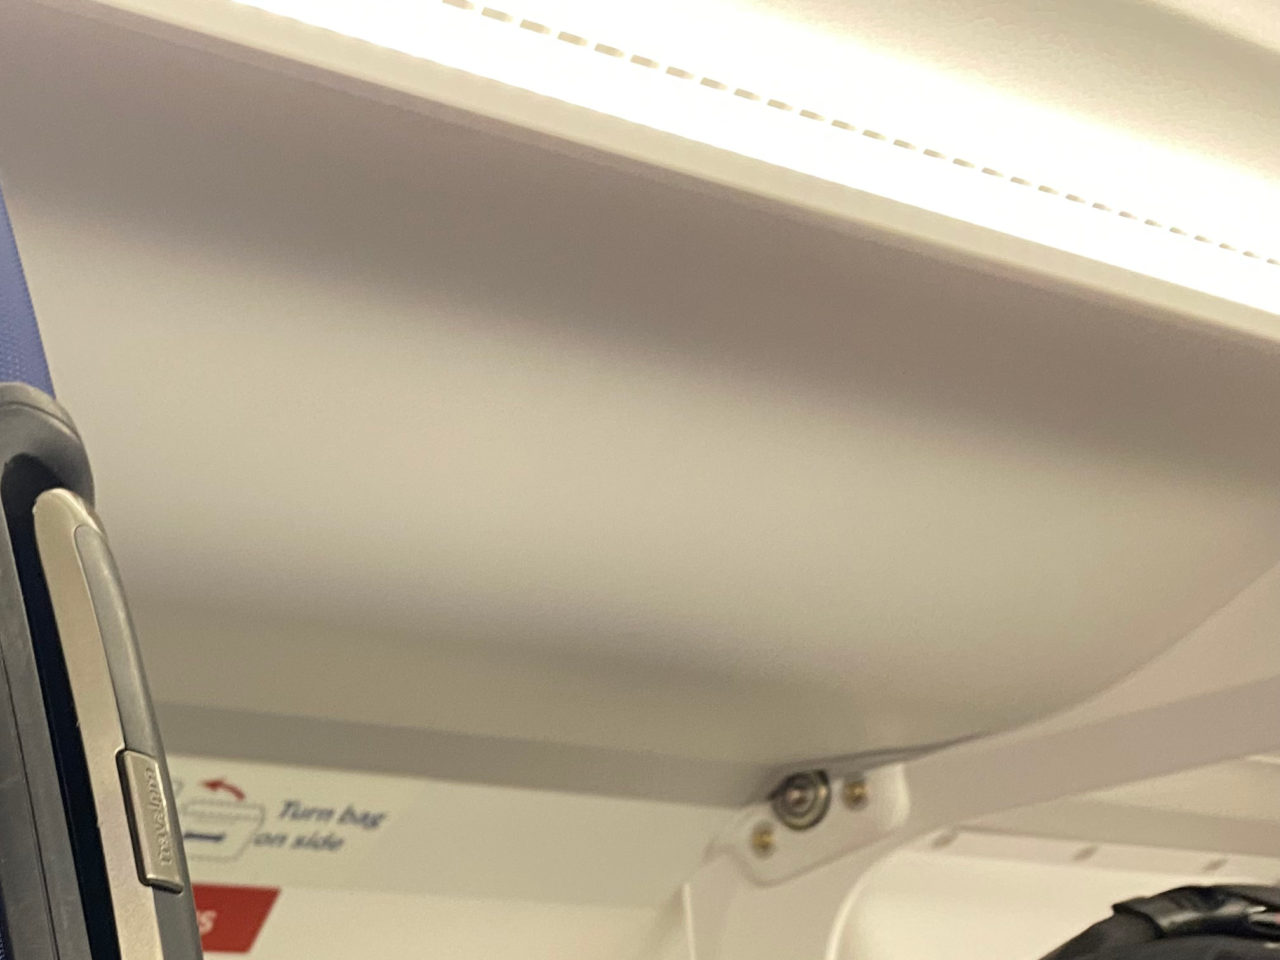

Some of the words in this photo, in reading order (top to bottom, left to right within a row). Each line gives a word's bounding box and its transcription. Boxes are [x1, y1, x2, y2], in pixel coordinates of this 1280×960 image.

[278, 800, 334, 822] Turn
[337, 804, 387, 830] bag
[253, 832, 287, 848] on
[291, 830, 345, 852] side
